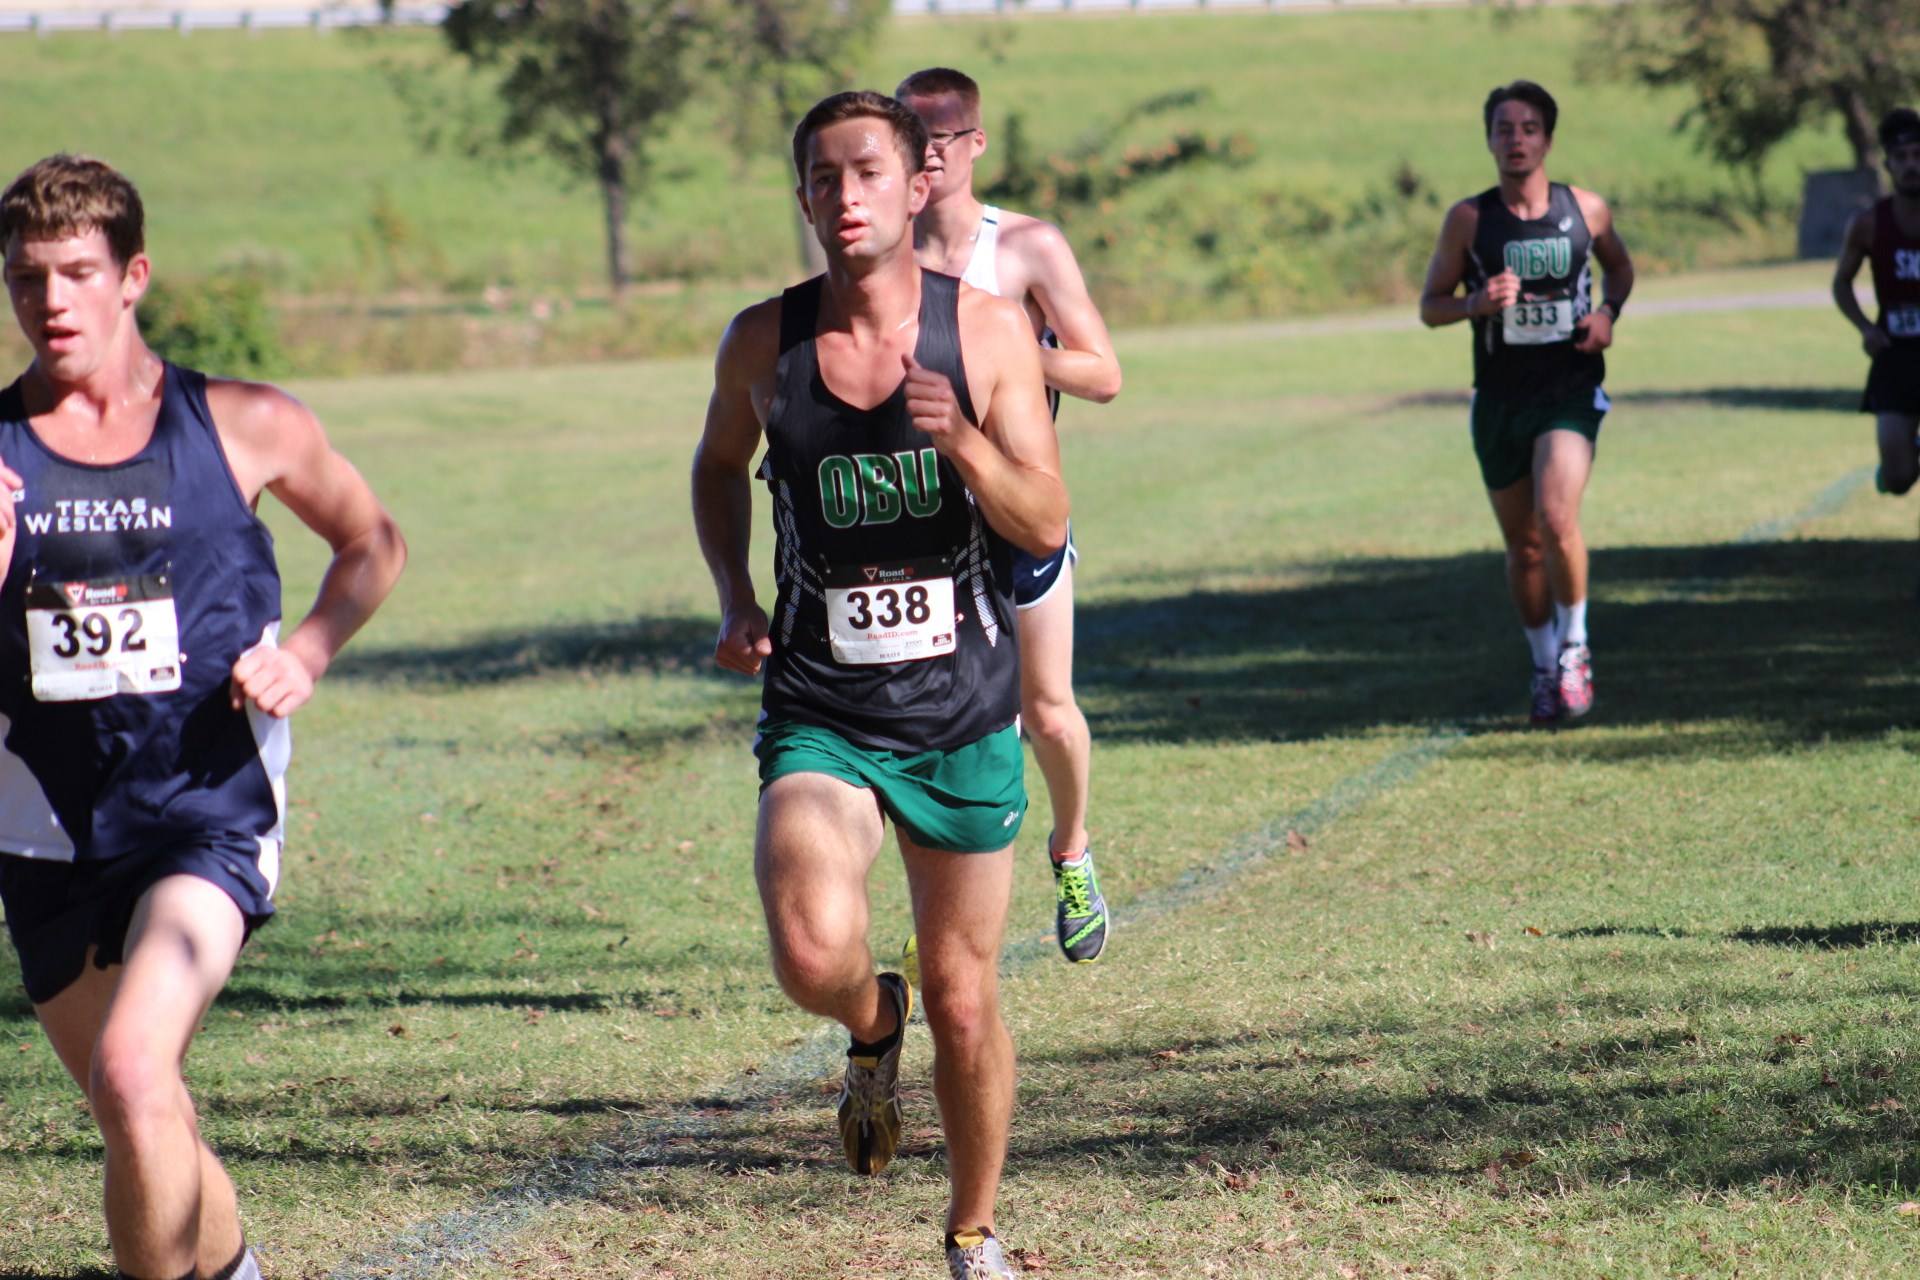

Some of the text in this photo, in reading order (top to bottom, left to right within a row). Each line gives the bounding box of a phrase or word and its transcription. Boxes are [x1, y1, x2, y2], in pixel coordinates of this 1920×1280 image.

[1503, 236, 1571, 280] OBU
[1515, 305, 1558, 326] 333
[56, 498, 147, 517] TEXAS
[818, 448, 942, 528] OBU
[24, 506, 172, 535] WESLEYAN
[846, 586, 931, 630] 338
[51, 608, 147, 658] 392
[1064, 914, 1104, 949] BROOKS
